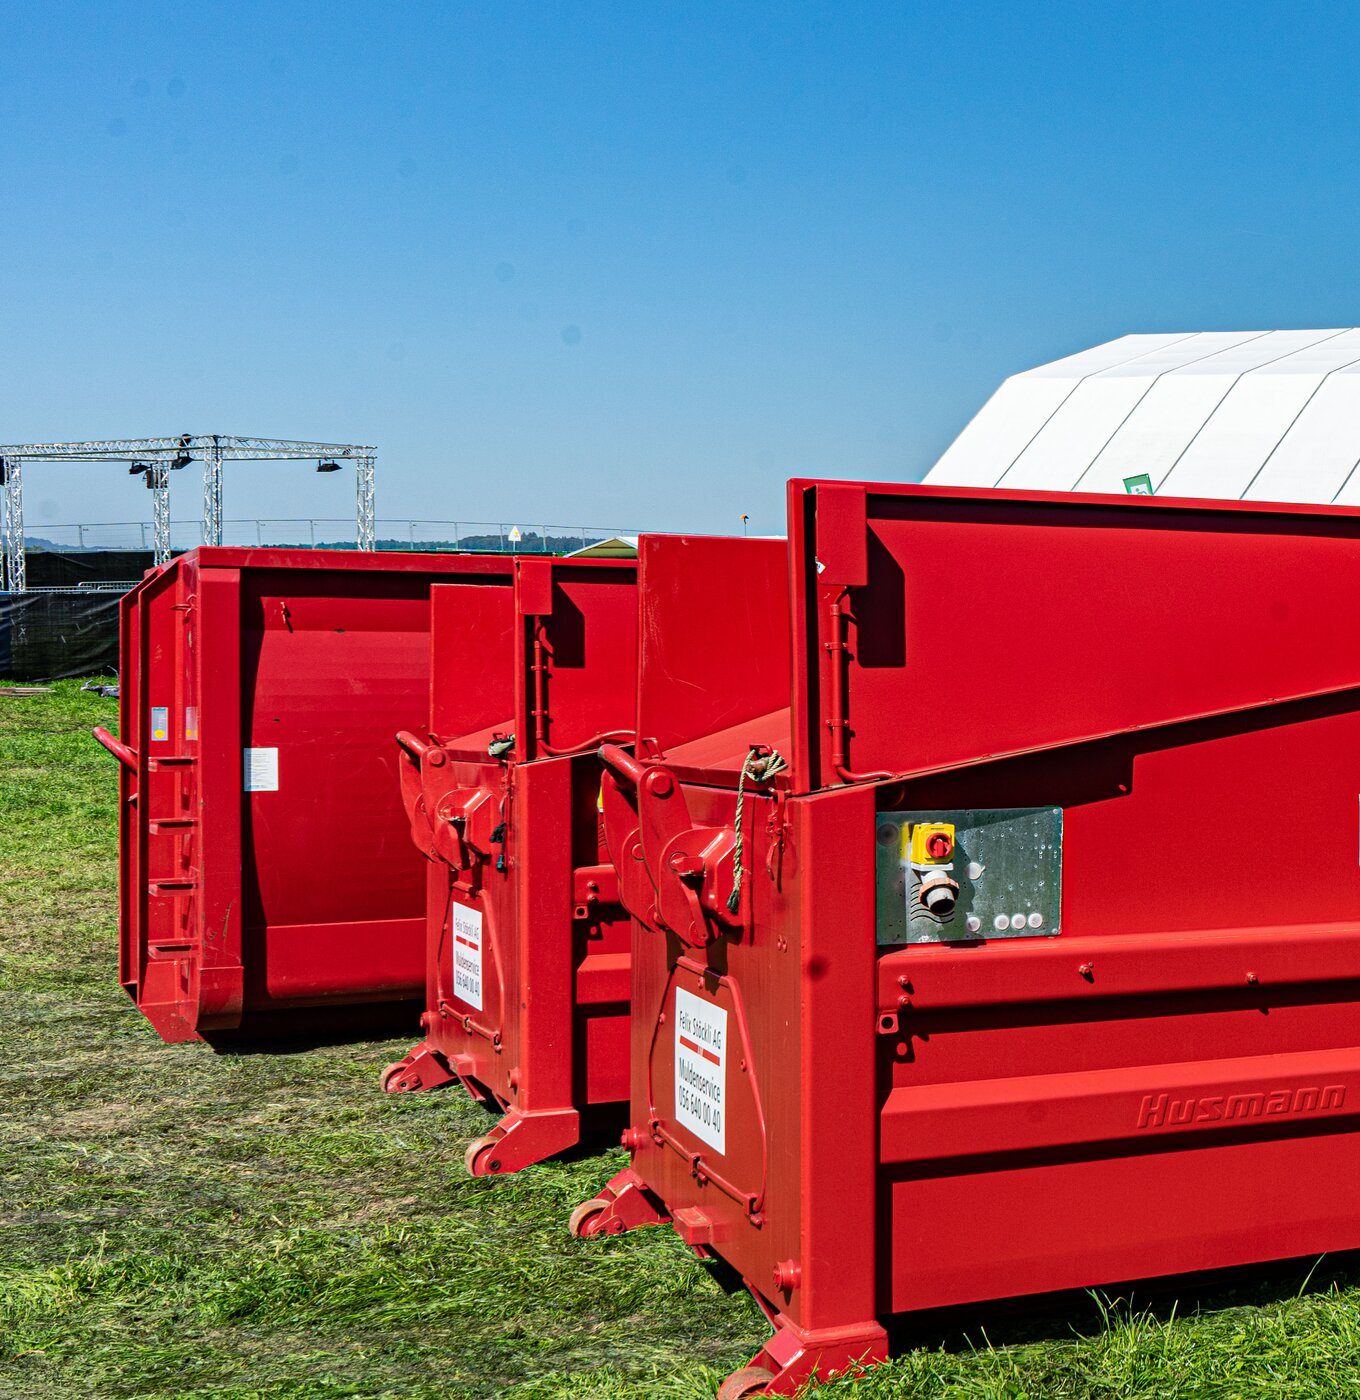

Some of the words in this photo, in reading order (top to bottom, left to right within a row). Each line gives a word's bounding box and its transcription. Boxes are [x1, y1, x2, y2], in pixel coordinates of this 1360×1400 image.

[679, 1010, 692, 1034] Felix
[692, 1018, 713, 1044] Stöckli
[713, 1029, 722, 1050] AG
[679, 1057, 721, 1104] Muldenservice
[679, 1085, 690, 1111] 056
[690, 1093, 702, 1120] 640
[703, 1102, 711, 1127] 00
[712, 1109, 721, 1133] 40
[1137, 1084, 1347, 1129] Husmann
